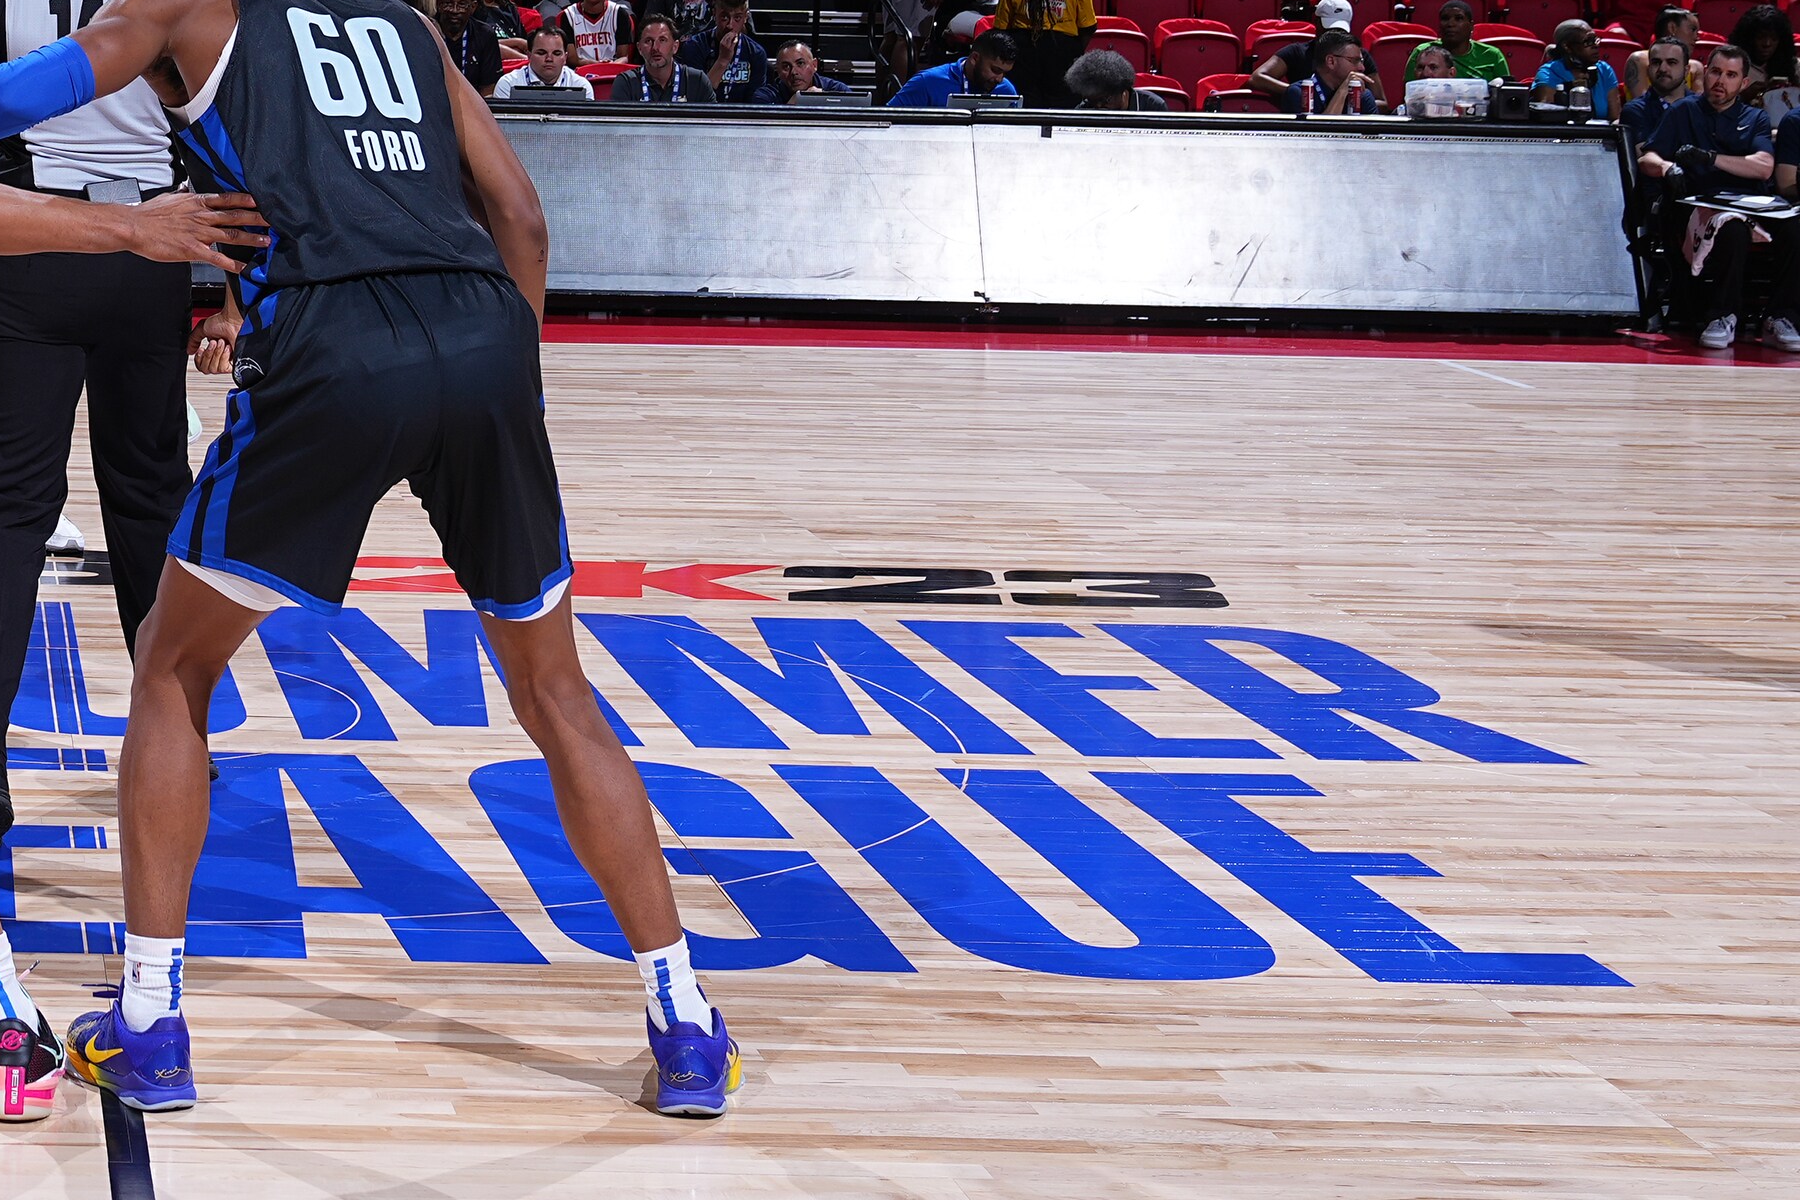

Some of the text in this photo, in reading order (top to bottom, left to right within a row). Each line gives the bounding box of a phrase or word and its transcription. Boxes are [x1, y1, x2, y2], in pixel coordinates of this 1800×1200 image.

[575, 32, 612, 49] ROCKETS
[287, 6, 423, 124] 60
[343, 129, 426, 172] FORD
